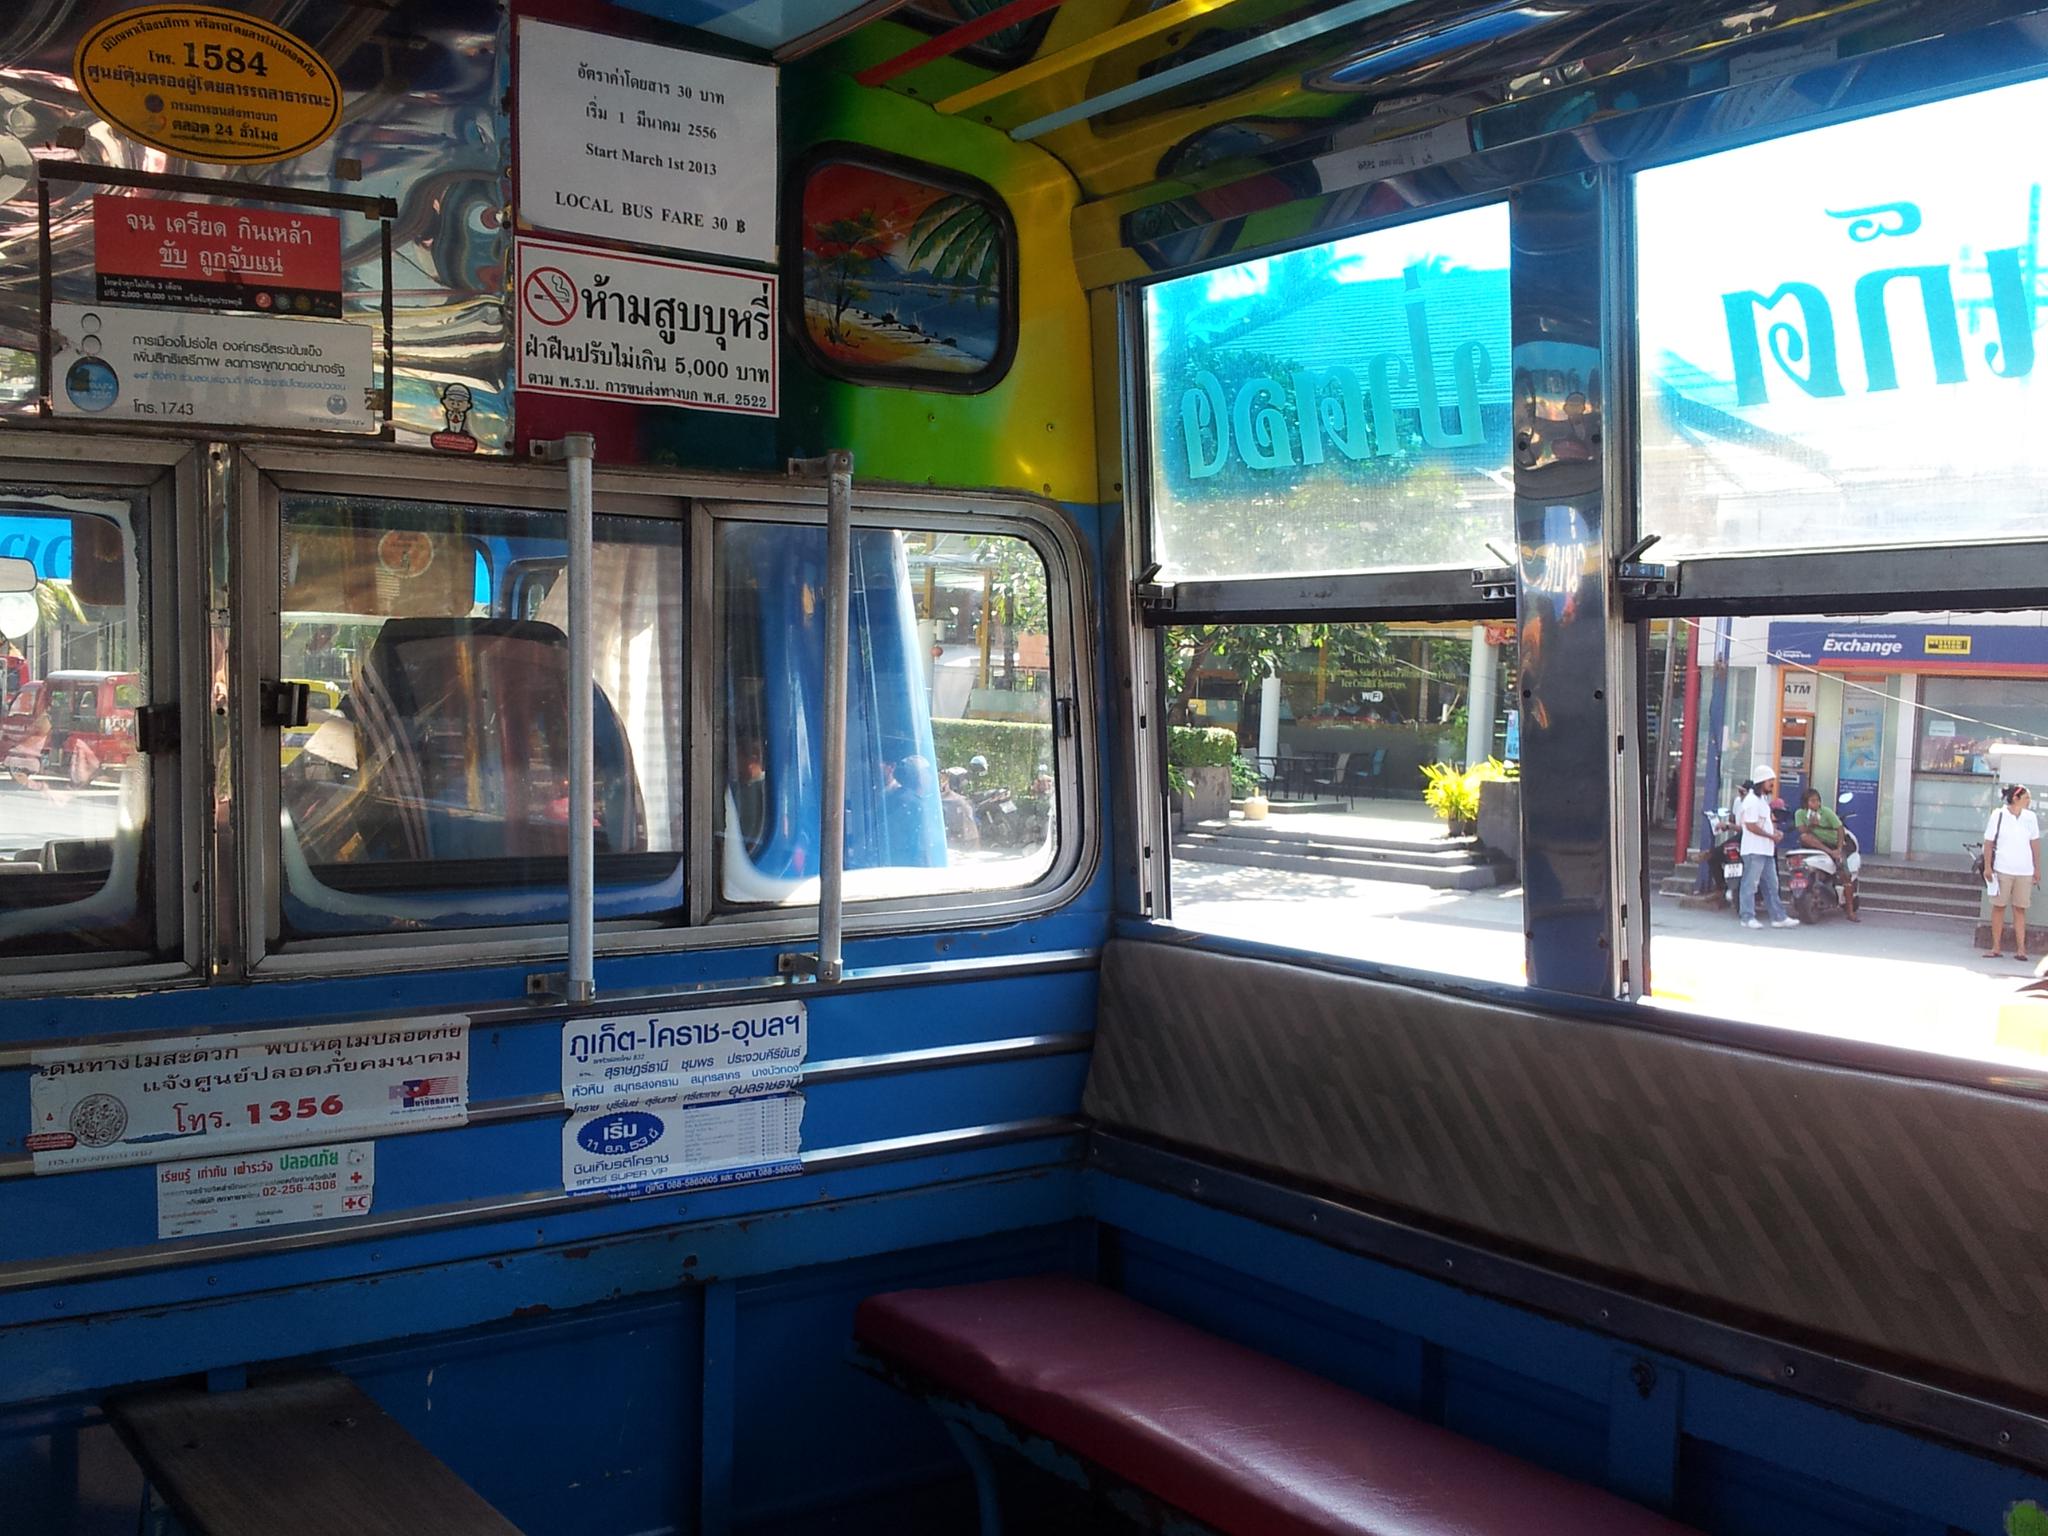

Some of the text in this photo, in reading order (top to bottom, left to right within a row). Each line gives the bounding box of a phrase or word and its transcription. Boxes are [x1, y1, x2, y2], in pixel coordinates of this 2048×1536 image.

[148, 42, 268, 77] โทร. 1584
[577, 60, 725, 105] อัตราค่าโดยสาร 30 บาท
[215, 122, 233, 136] 24
[585, 95, 717, 140] เริ่ม 1 มีนาคม 2556
[585, 142, 717, 176] Start March 1st 2013
[126, 211, 312, 246] จน เครียด กินเหล้า
[554, 191, 614, 214] LOCAL
[621, 202, 654, 220] BUS
[661, 207, 705, 228] FARE
[711, 215, 728, 231] 30
[159, 240, 284, 277] ขับ ถูกจับแน่
[580, 274, 771, 352] ห้ามสูบบุหรี่
[132, 334, 218, 351] การเมืองโปร่งใส
[525, 334, 770, 384] ฝ่าฝืนปรับไม่เกิน 5,000 บาท
[527, 371, 768, 409] ตาม พ.ร.บ. การขนส่งทางบก พ.ศ. 2522
[1823, 638, 1903, 657] Exchange
[1785, 684, 1812, 695] ATM
[570, 1014, 800, 1064] ภูเก็ต-โคราช-อุบลฯ
[604, 1059, 669, 1080] สุราษฎร์ธานี
[681, 1056, 714, 1072] ชุมพร
[727, 1045, 802, 1065] ประจวบคีรีขันธ์
[571, 1064, 801, 1098] หัวหิน สมุทรสงคราม สมุทรสาคร บางบัวทอง
[728, 1076, 804, 1099] อุบลราชธานี
[172, 1094, 344, 1133] โทร. 1356
[603, 1117, 638, 1141] เริ่ม
[586, 1138, 599, 1151] 11
[605, 1144, 626, 1153] ต.ค.
[629, 1136, 648, 1151] 53
[160, 1168, 192, 1184] เรียนรู้
[233, 1160, 274, 1176] เฝ้าระวัง
[279, 1149, 339, 1172] ปลอดภัย
[610, 1169, 648, 1182] SUPER
[651, 1166, 668, 1177] VIP
[262, 1180, 337, 1198] 02-256-4308
